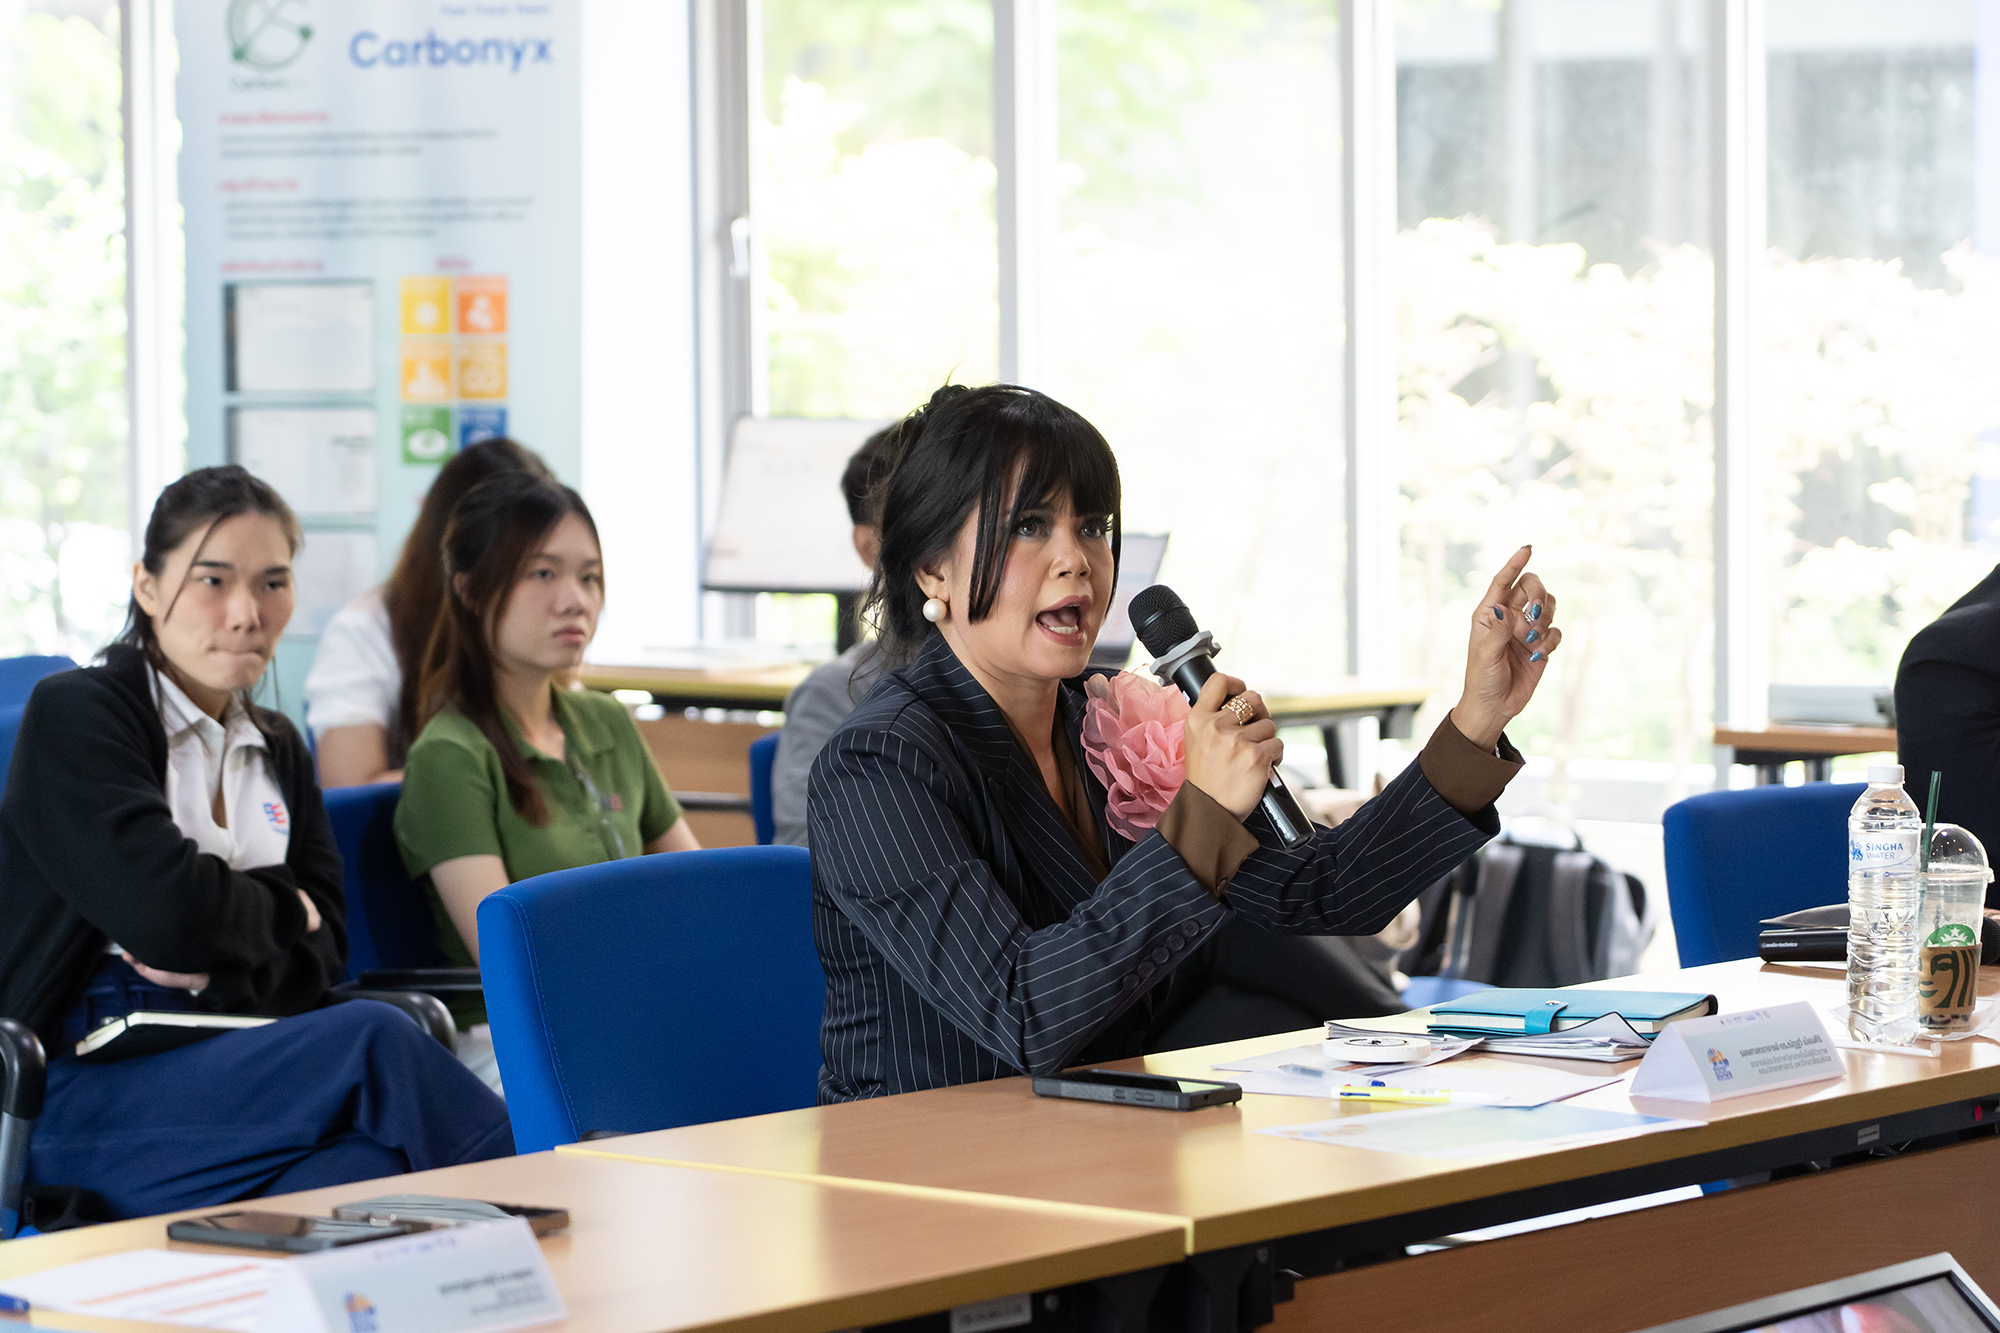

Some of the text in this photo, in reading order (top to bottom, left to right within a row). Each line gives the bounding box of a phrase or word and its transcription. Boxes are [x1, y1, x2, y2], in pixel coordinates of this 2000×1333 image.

[349, 28, 553, 73] Carbonyx
[1865, 843, 1904, 851] SINGHA
[1865, 852, 1896, 860] WATER
